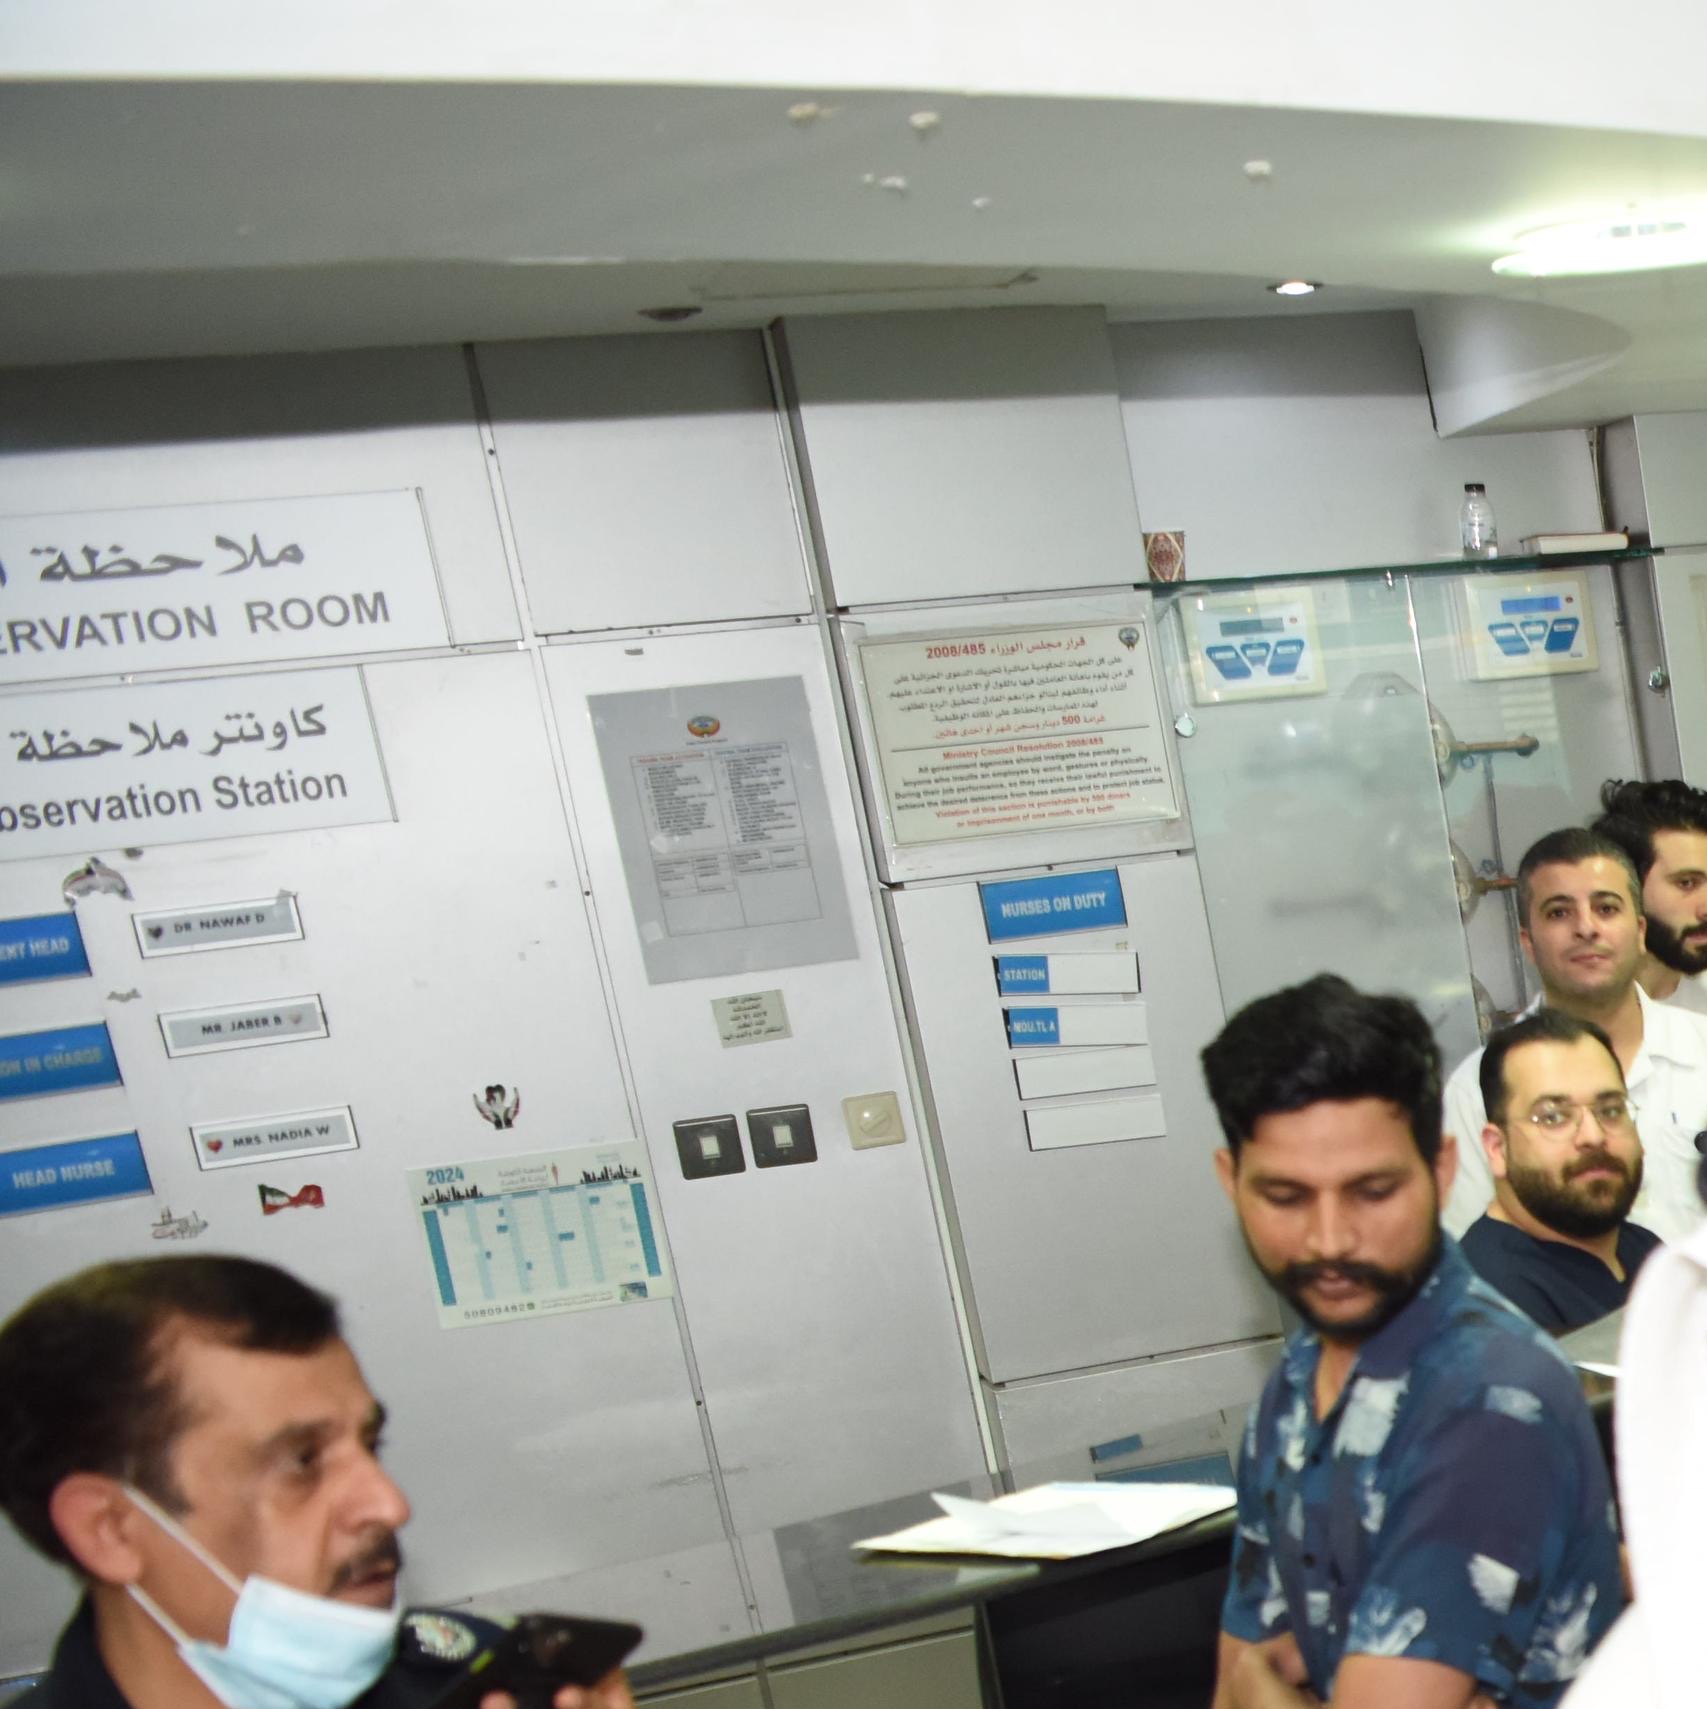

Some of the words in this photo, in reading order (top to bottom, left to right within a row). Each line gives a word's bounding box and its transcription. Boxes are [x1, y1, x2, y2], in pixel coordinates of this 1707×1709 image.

[30, 533, 305, 582] ملاحظة
[245, 591, 390, 634] ROOM
[925, 643, 987, 660] 2008/485
[200, 704, 328, 757] كاونتر
[1061, 714, 1081, 725] 500
[9, 719, 190, 763] ملاحظة
[943, 750, 978, 761] Ministry
[212, 772, 348, 811] Station
[1002, 900, 1050, 918] NURSES
[1053, 897, 1072, 912] ON
[1074, 891, 1106, 909] DUTY
[199, 915, 255, 931] NAWAF
[1004, 969, 1046, 981] STATION
[269, 1128, 313, 1144] NADIA
[12, 1162, 57, 1188] HEAD
[61, 1159, 115, 1181] NURSE
[426, 1166, 465, 1185] 2024
